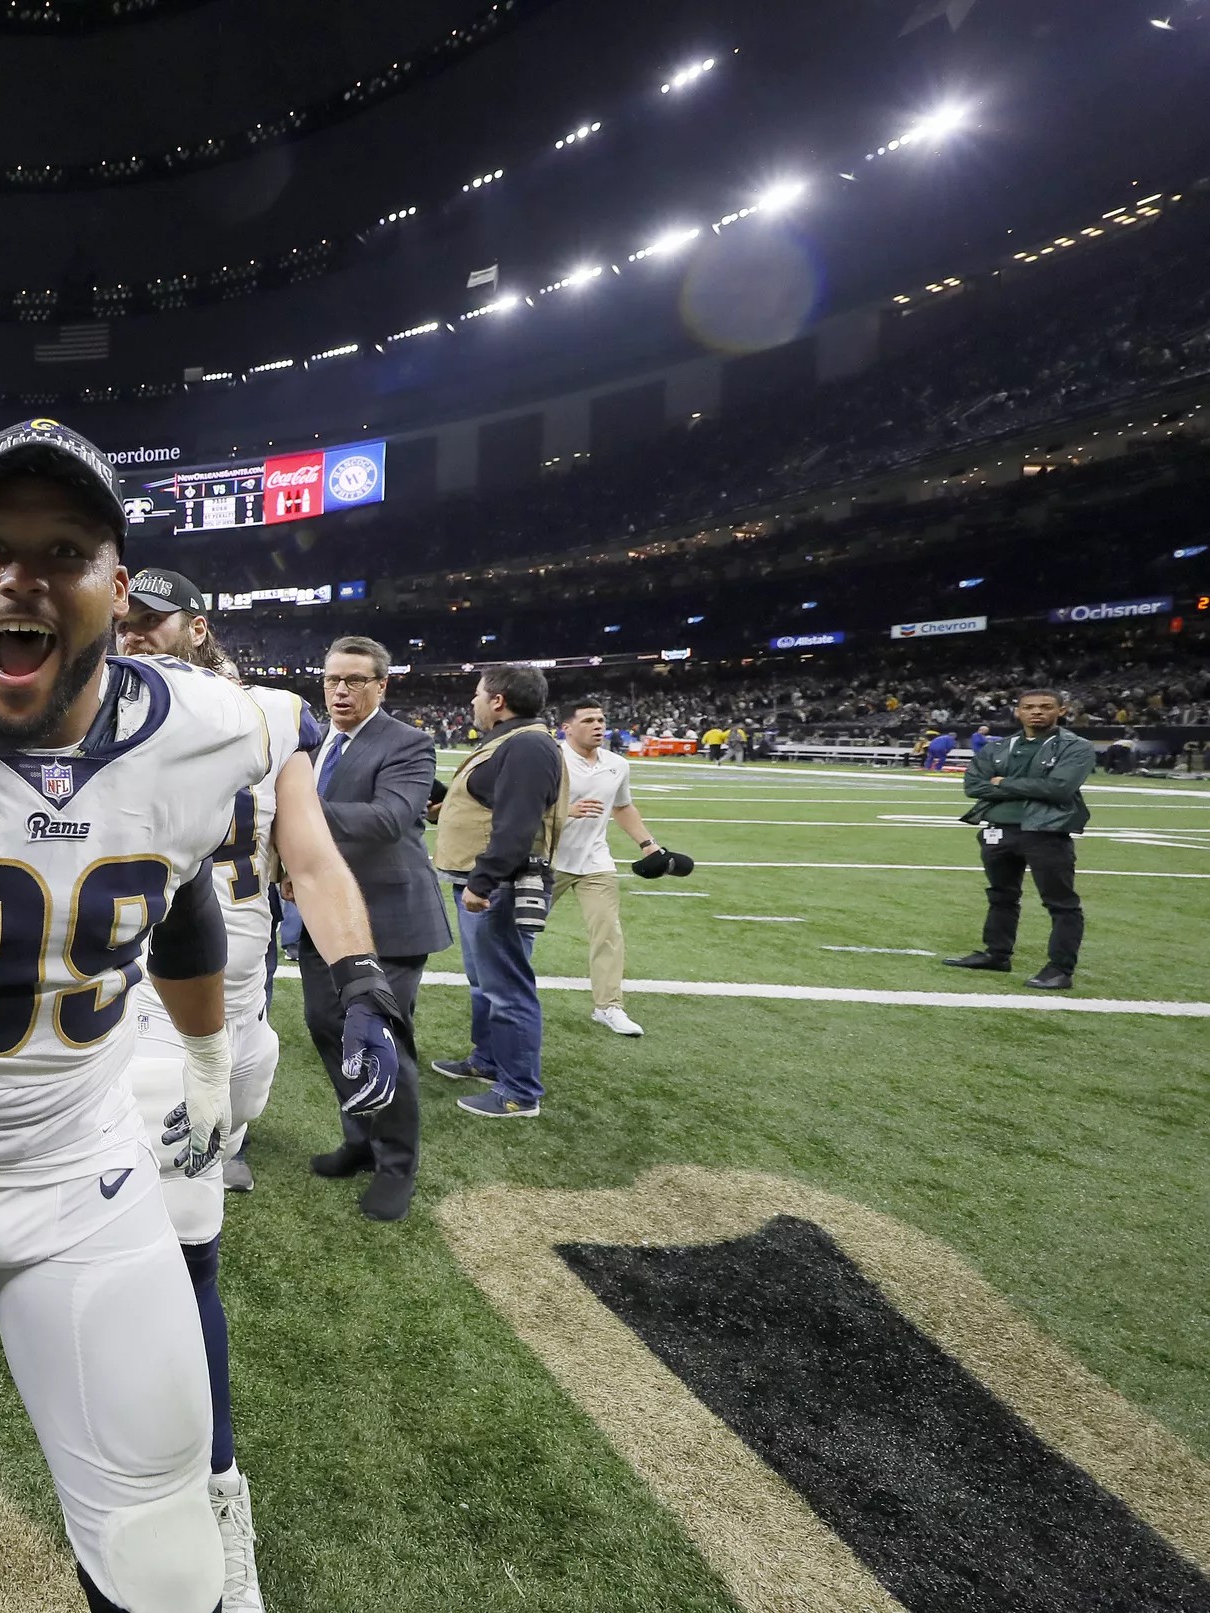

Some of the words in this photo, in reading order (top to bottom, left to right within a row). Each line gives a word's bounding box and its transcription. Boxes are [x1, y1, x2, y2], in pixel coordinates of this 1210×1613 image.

[105, 446, 181, 465] perdome
[333, 458, 374, 479] HANCOCK
[212, 484, 226, 496] VS
[128, 577, 173, 597] PIONS
[1070, 601, 1165, 621] Ochsner
[921, 619, 977, 634] Chevron
[793, 634, 835, 647] Allstate
[46, 779, 69, 795] NFL
[27, 811, 91, 839] Rams
